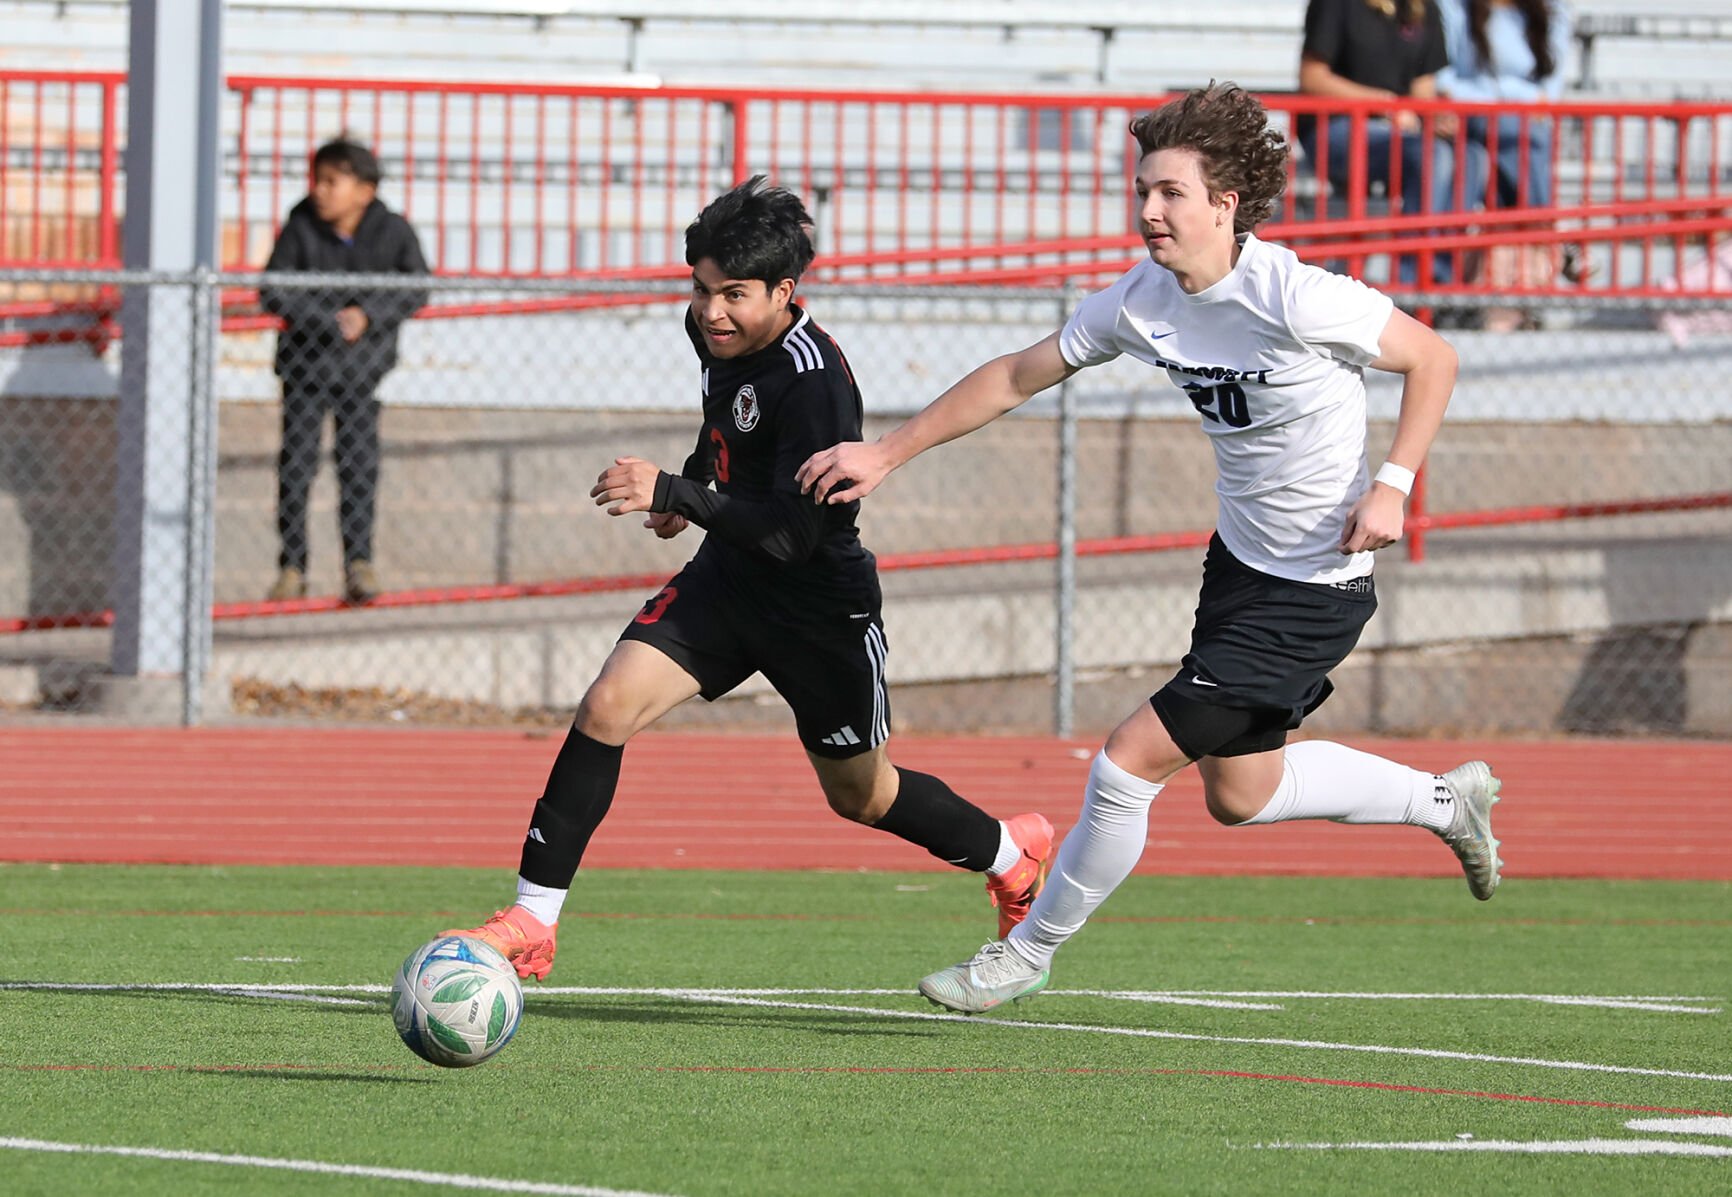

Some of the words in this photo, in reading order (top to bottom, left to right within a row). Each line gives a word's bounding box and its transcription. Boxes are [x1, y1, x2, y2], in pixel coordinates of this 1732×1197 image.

[1182, 381, 1253, 429] 20
[710, 427, 731, 484] 3
[634, 586, 678, 625] 3
